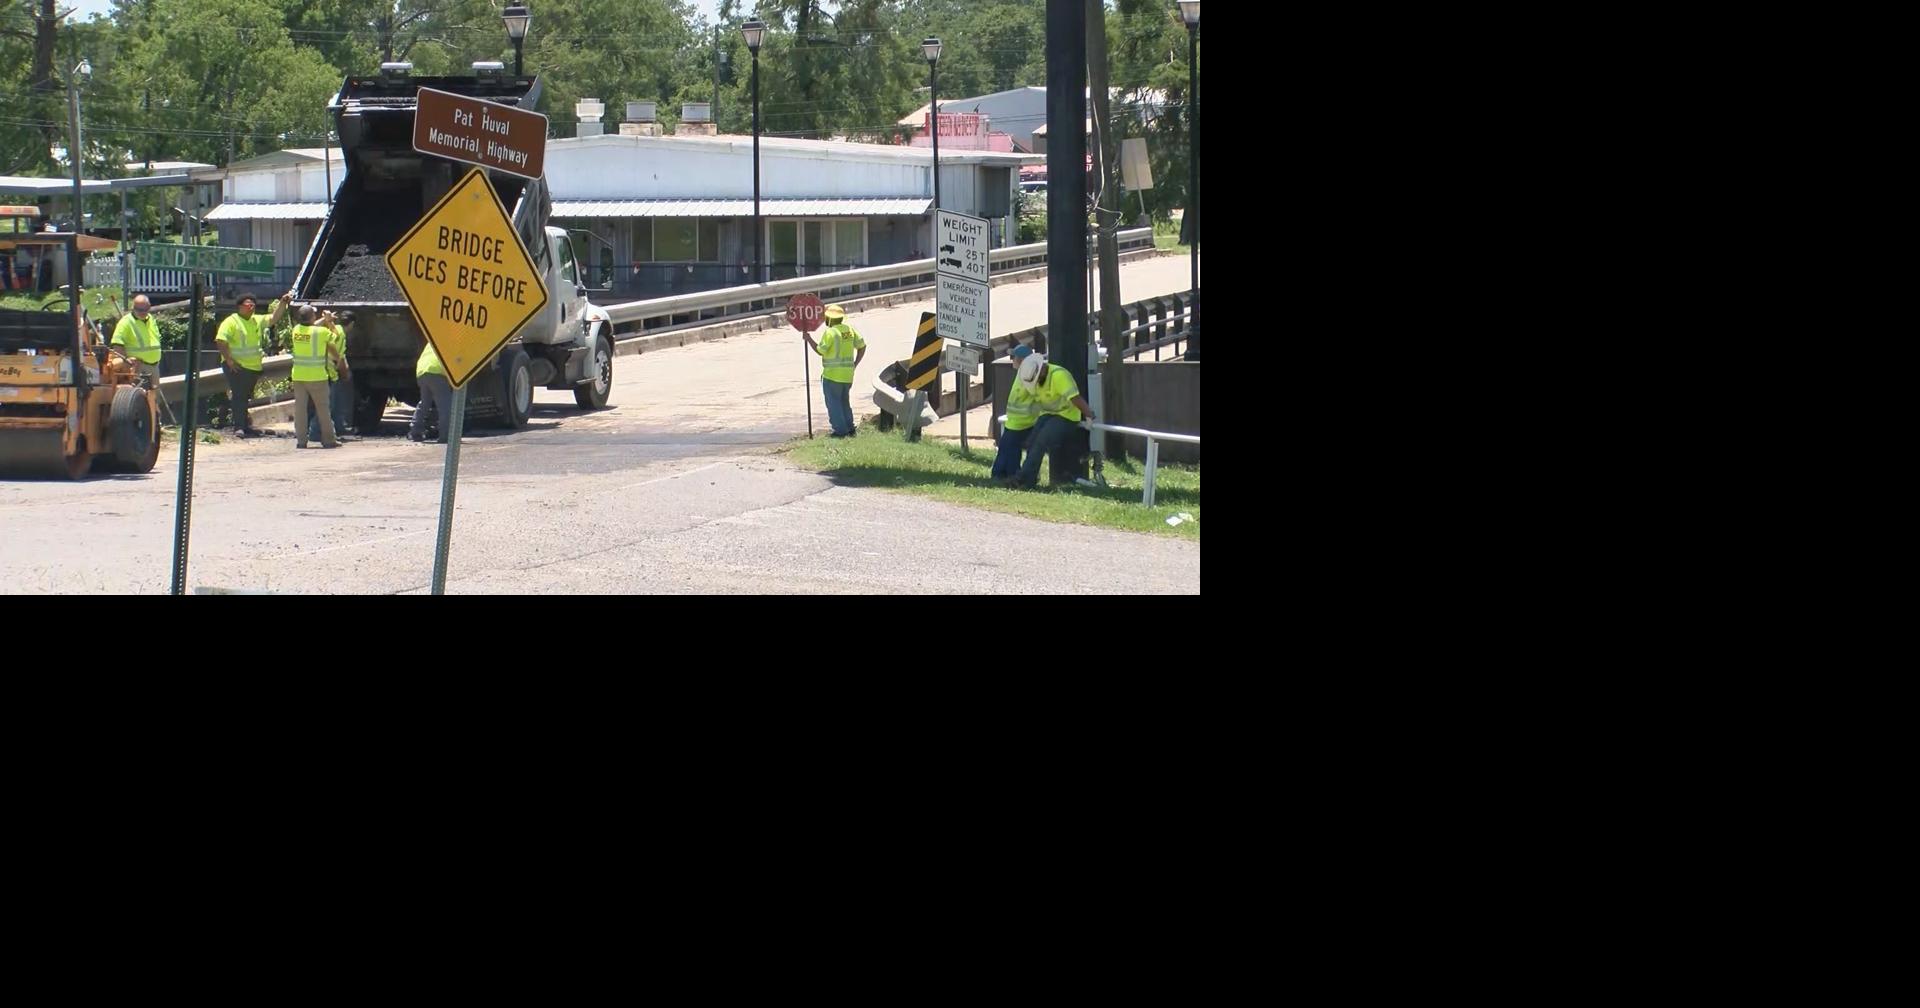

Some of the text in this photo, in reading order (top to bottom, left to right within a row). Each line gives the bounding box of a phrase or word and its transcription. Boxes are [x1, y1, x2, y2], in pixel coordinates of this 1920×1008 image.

[454, 108, 510, 136] Pat Huval
[429, 127, 528, 168] Memorial Highway
[943, 217, 982, 236] WEIGHT
[438, 226, 505, 264] BRIDGE
[949, 231, 976, 247] LIMIT
[246, 254, 261, 264] WY
[408, 253, 527, 305] ICES BEFORE
[943, 282, 983, 296] EMERGENCY
[950, 293, 976, 307] VEHICLE
[440, 296, 488, 329] ROAD
[789, 306, 823, 320] STOP
[939, 301, 959, 313] SINGLE
[960, 307, 976, 318] AXLE
[939, 312, 961, 324] TANDEM
[939, 323, 958, 334] GROSS
